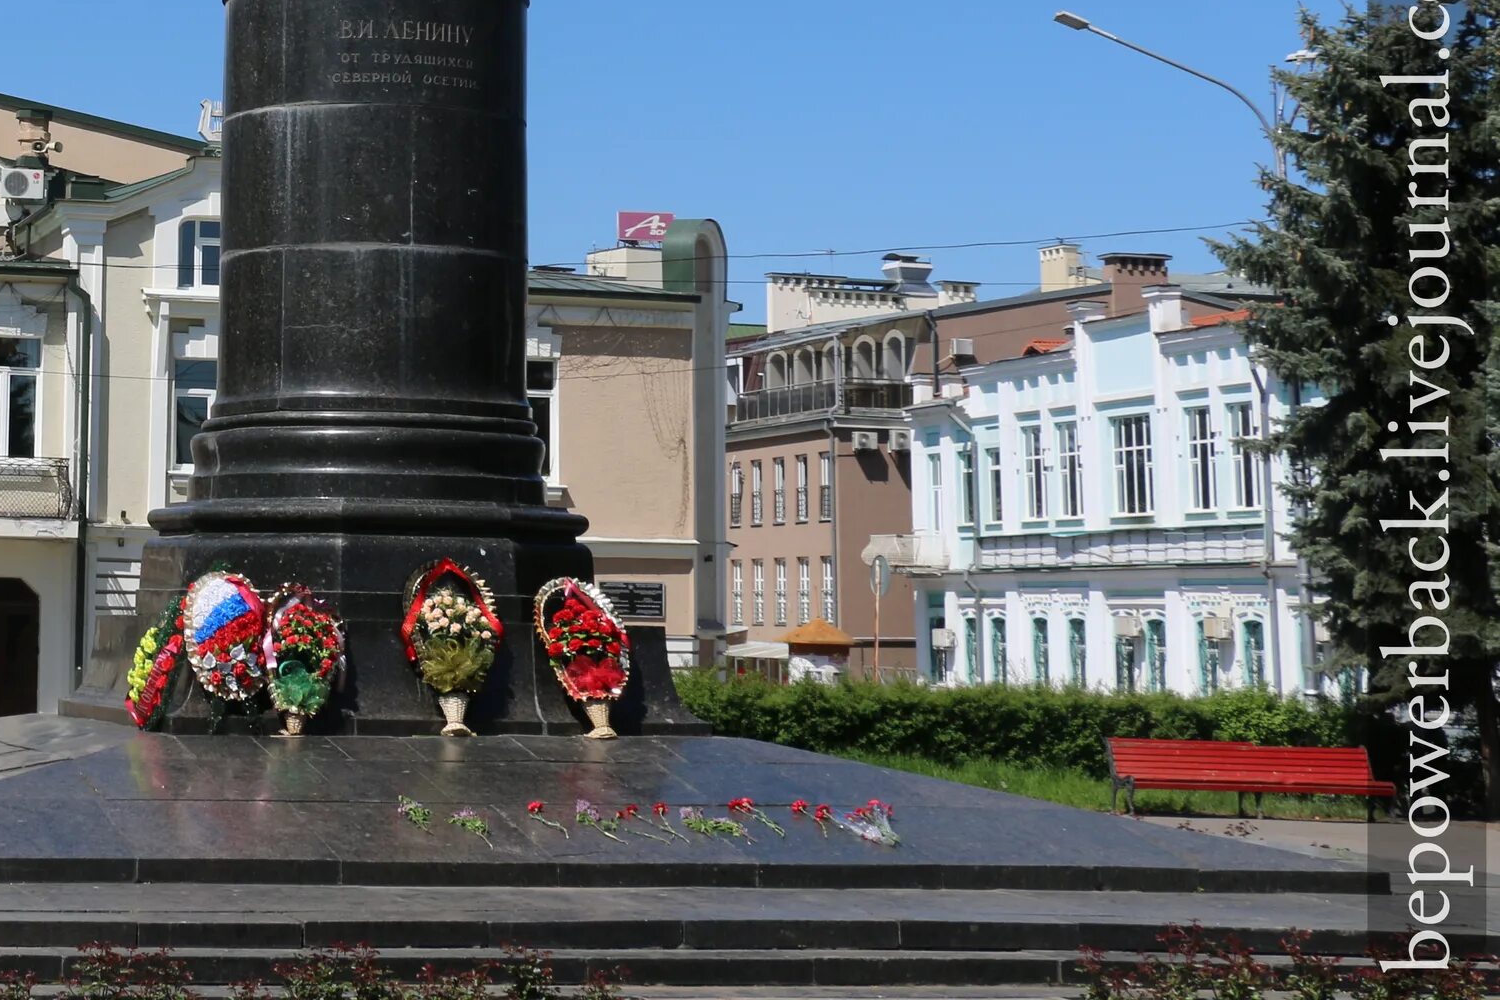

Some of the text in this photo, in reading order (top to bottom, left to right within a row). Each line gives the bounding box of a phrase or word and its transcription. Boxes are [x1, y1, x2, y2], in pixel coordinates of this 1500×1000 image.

[383, 20, 474, 46] ЛЕНИНУ
[340, 52, 361, 64] ОТ
[331, 70, 478, 89] СЕВЕРНОЙ ОСЕТИИ
